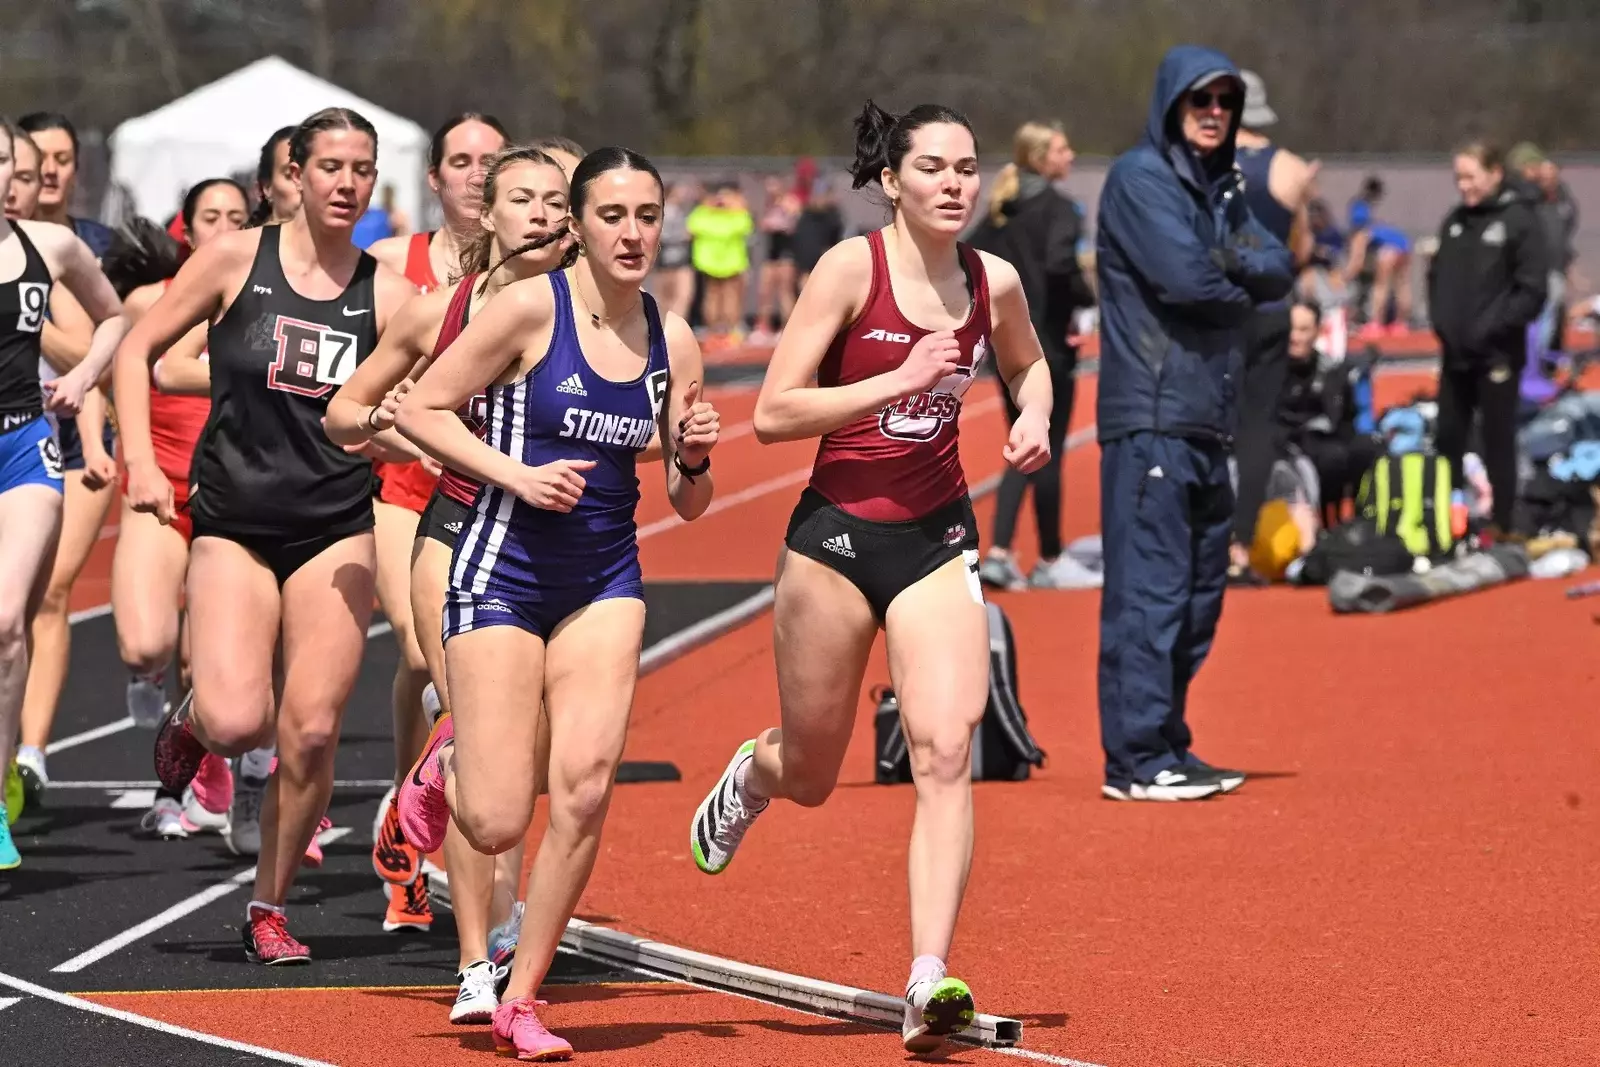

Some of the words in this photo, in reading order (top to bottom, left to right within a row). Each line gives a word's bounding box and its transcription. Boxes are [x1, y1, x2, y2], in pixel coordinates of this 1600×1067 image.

[24, 286, 45, 328] 9
[266, 314, 334, 399] B
[324, 333, 353, 379] 7
[555, 384, 588, 397] adidas
[822, 540, 857, 559] adidas
